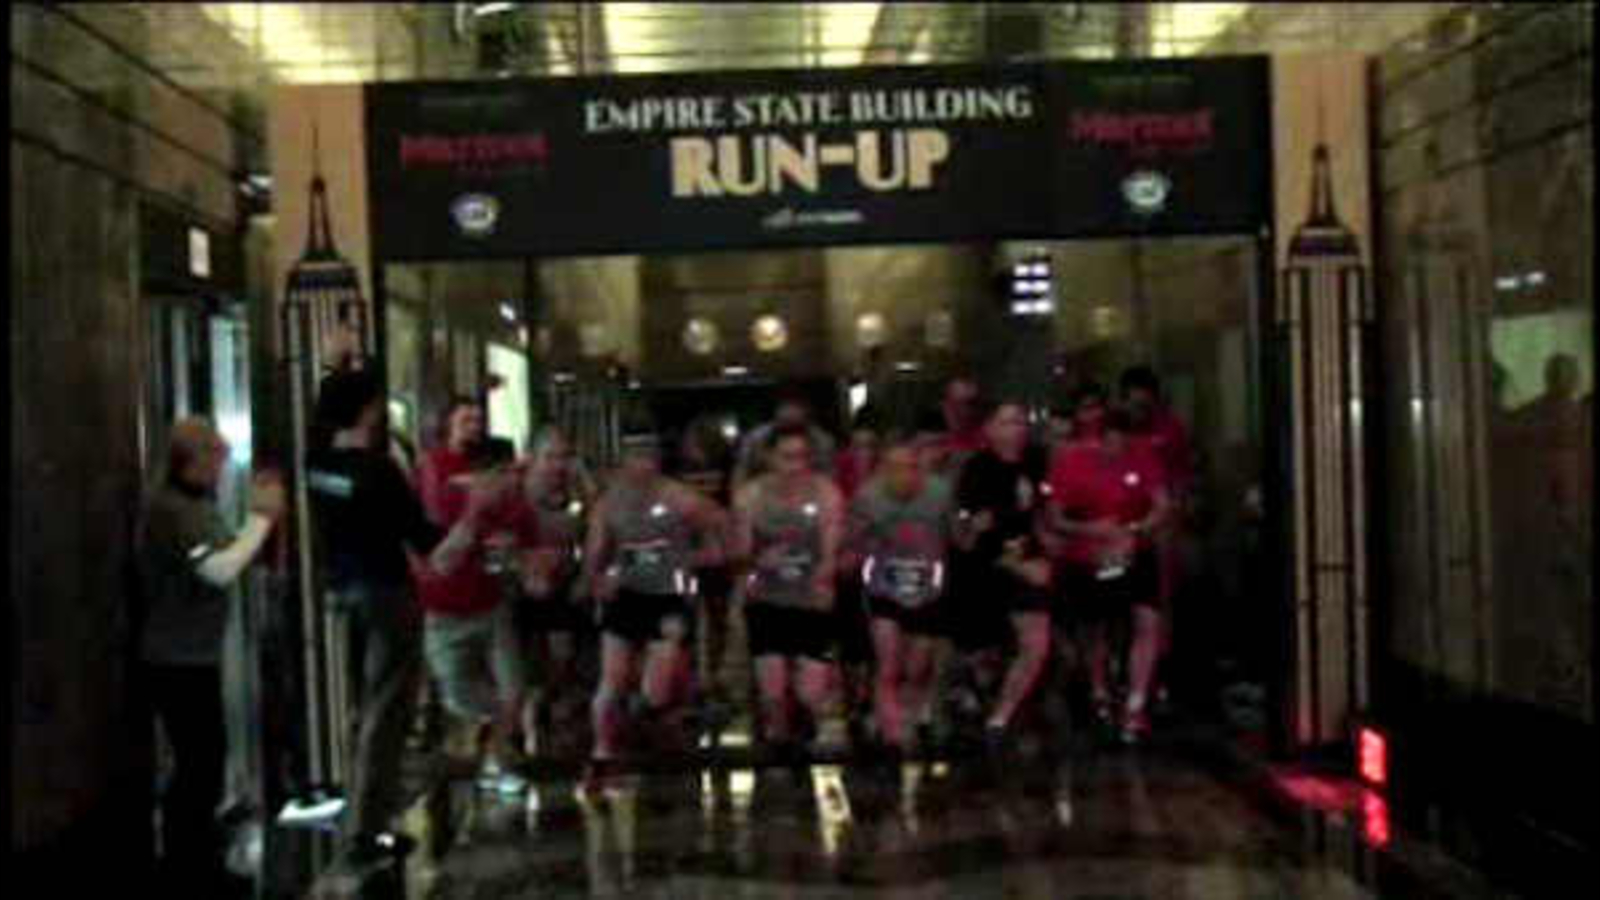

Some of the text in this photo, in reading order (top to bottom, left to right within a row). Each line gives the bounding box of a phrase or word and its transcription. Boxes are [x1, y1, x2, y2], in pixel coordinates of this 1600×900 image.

[585, 87, 1032, 132] EMPIRE STATE BUILDING
[671, 130, 950, 197] RUN-UP
